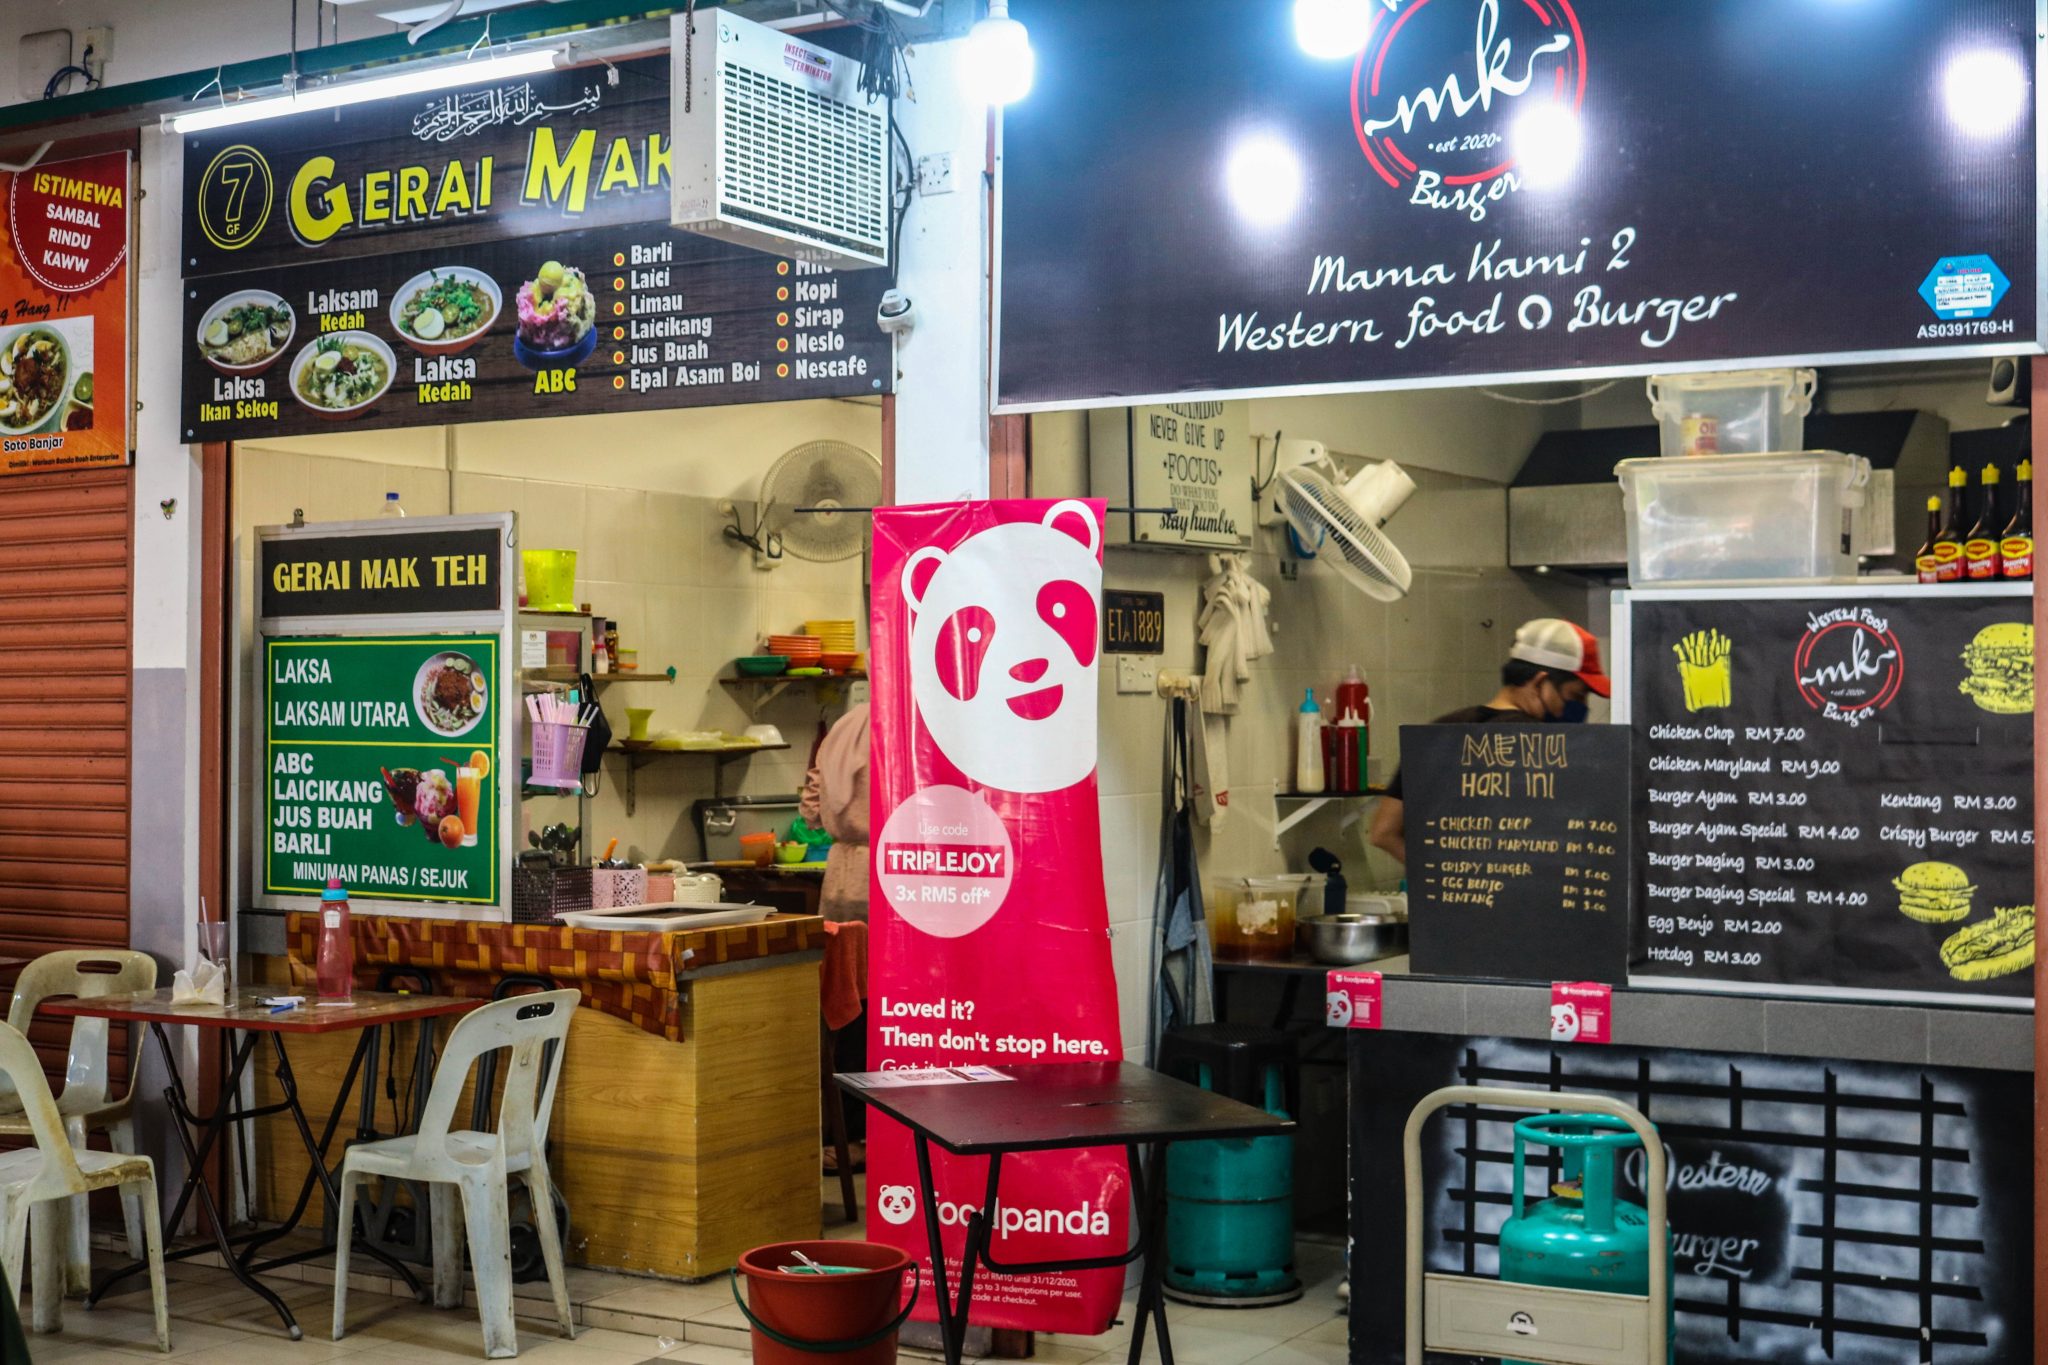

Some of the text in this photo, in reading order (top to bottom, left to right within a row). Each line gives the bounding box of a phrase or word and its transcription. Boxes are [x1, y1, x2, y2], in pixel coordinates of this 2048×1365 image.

[784, 42, 807, 60] INSECT
[791, 59, 832, 81] TERMINATOR
[1435, 134, 1497, 153] est 2020
[33, 172, 123, 209] ISTIMEWA
[220, 161, 254, 223] 7
[286, 154, 496, 248] GERAI
[1409, 170, 1522, 222] Burger
[46, 203, 101, 229] SAMBAL
[48, 227, 91, 250] RINDU
[225, 222, 241, 236] GF
[43, 249, 90, 274] KAWW
[630, 241, 673, 265] Barli
[1307, 226, 1637, 295] Mama Kami 2
[630, 267, 671, 290] Laici
[308, 287, 379, 315] Laksam
[795, 278, 838, 304] Kopi
[630, 292, 683, 315] Limau
[320, 310, 365, 332] Kedah
[630, 315, 713, 341] Laicikang
[794, 306, 844, 330] Sirap
[1216, 284, 1738, 354] Western food Burger
[1917, 318, 2014, 339] AS0391769-H
[630, 340, 709, 365] Jus Buah
[795, 331, 845, 355] Neslo
[414, 356, 477, 383] Laksa
[630, 360, 761, 393] Epal Asam Boi
[795, 354, 867, 380] Nescafe
[214, 376, 265, 401] Laksa
[418, 381, 472, 405] Kedah
[533, 367, 577, 395] ABC
[201, 399, 279, 422] Ikan Sekoq
[4, 435, 64, 453] Soto Banjar
[1150, 413, 1225, 451] NEVER GIVE UP
[1168, 452, 1217, 486] FOCUS
[1159, 511, 1189, 540] stay
[273, 554, 487, 593] GERAI MAK TEH
[275, 658, 332, 685] LAKSA
[275, 700, 410, 728] LAKSAM UTARA
[1822, 701, 1875, 727] Burger
[1649, 724, 1806, 745] Chicken Chop RM 7.00
[1461, 732, 1568, 769] MENU
[274, 752, 314, 775] ABC
[1649, 756, 1840, 779] Chicken Maryland RM 9.00
[274, 779, 383, 803] LAICIKANG
[1461, 771, 1510, 798] HARI
[1648, 788, 1807, 811] Burger Ayam RM 3.00
[1880, 793, 2017, 813] Kentang RM 3.00
[274, 806, 373, 831] JUS BUAH
[918, 822, 968, 836] Use code
[1440, 816, 1617, 833] CHICKEN CHOP RM 7.00
[274, 831, 331, 856] BARLI
[1648, 820, 1860, 843] Burger Ayam Special RM 4.00
[1879, 824, 2018, 849] Crispy Burger RM
[1440, 836, 1615, 855] CHICKEN MARYLAND RM 9.00
[888, 850, 1001, 874] TRIPLEJOY
[1441, 860, 1482, 875] CRISPY
[1486, 862, 1533, 878] BURGER
[1648, 851, 1815, 873] Burger Daging RM 3.00
[293, 861, 469, 889] MINUMAN PANAS SEJUK
[1442, 876, 1463, 889] EGG
[896, 885, 916, 902] 3x
[921, 886, 957, 903] RM5
[1442, 891, 1495, 908] KENTANG
[1647, 883, 1868, 907] Burger Daging Special RM 4.00
[1648, 914, 1782, 937] Egg Benjo RM 2.00
[1648, 946, 1762, 966] Hotdog RM 3.00
[881, 997, 975, 1021] Loved it?
[880, 1026, 1109, 1058] Then don't stop here.
[1624, 1142, 1771, 1196] Western
[991, 1273, 1078, 1288] RM10 until 31/12/2020.
[1001, 1285, 1049, 1296] redemptions
[1050, 1290, 1063, 1298] per
[971, 1293, 1038, 1305] code at checkout.
